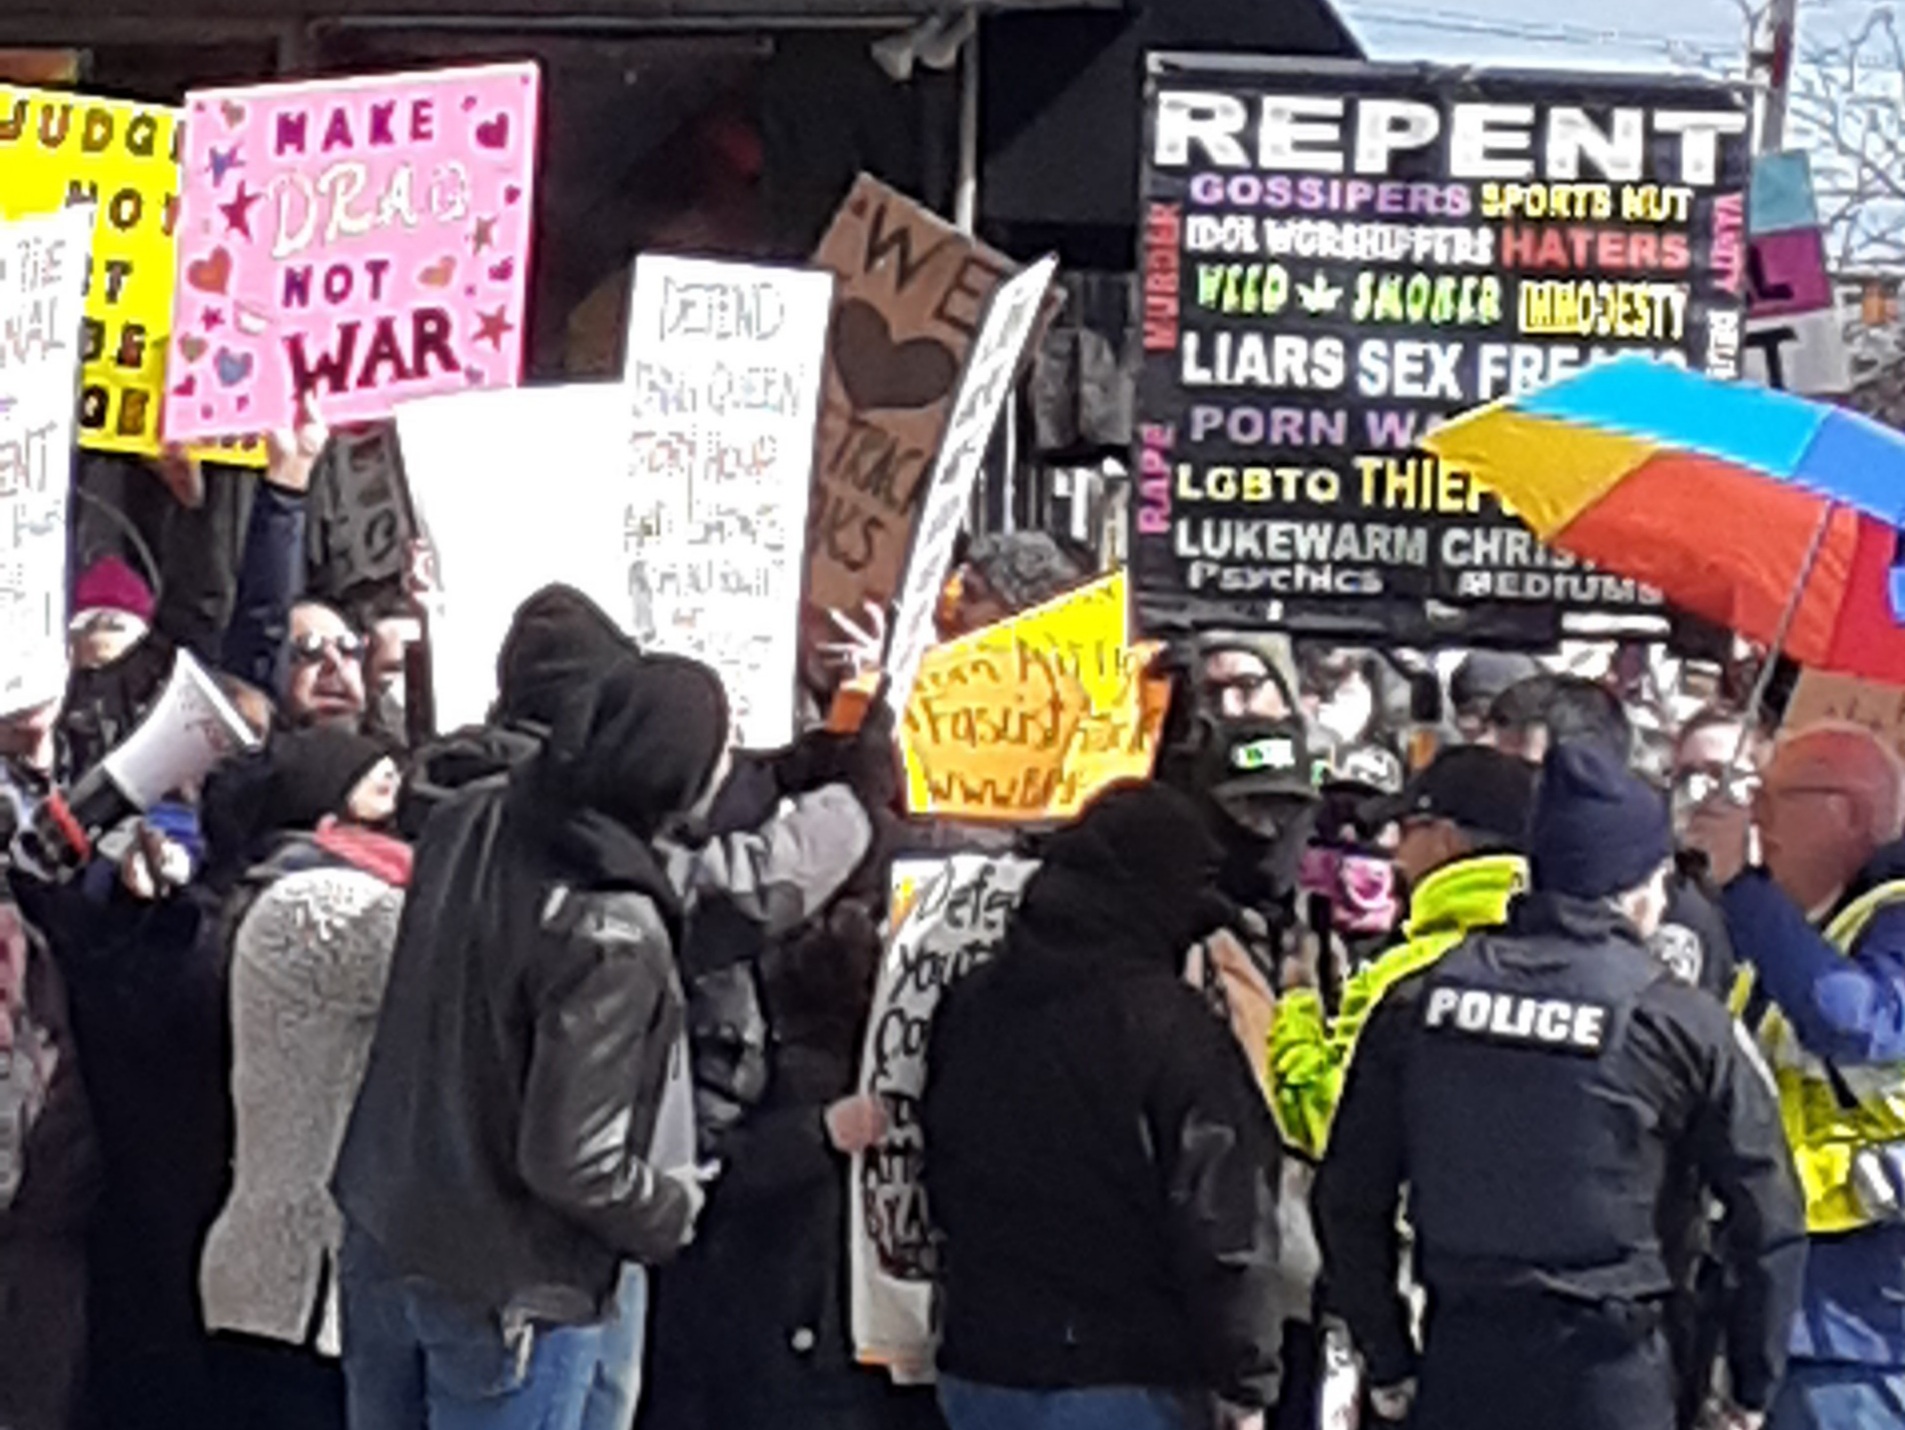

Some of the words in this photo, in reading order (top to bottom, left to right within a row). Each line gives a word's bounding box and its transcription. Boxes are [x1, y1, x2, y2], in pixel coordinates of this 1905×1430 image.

[275, 100, 435, 157] MAKE
[1153, 91, 1747, 186] REPENT
[267, 160, 471, 260] DRAG
[1189, 172, 1472, 217] GOSSIPERS
[1481, 182, 1612, 219] SPORTS
[1621, 184, 1695, 222] NUT
[1186, 214, 1259, 252] IDOL
[1501, 225, 1692, 271] HATERS
[281, 260, 390, 308] NOT
[863, 200, 1003, 340] WE
[1142, 202, 1183, 350] MURDER
[1197, 262, 1289, 315] WEED
[1353, 270, 1501, 326] SMOKER
[1518, 279, 1691, 340] IMMODESTY
[281, 307, 462, 398] WAR
[1181, 331, 1345, 389] LIARS
[1357, 339, 1464, 400] SEX
[1189, 404, 1348, 446] PORN
[1138, 423, 1176, 534] RAPE
[1175, 517, 1429, 567] LUKEWARM
[1425, 987, 1605, 1047] POLICE
